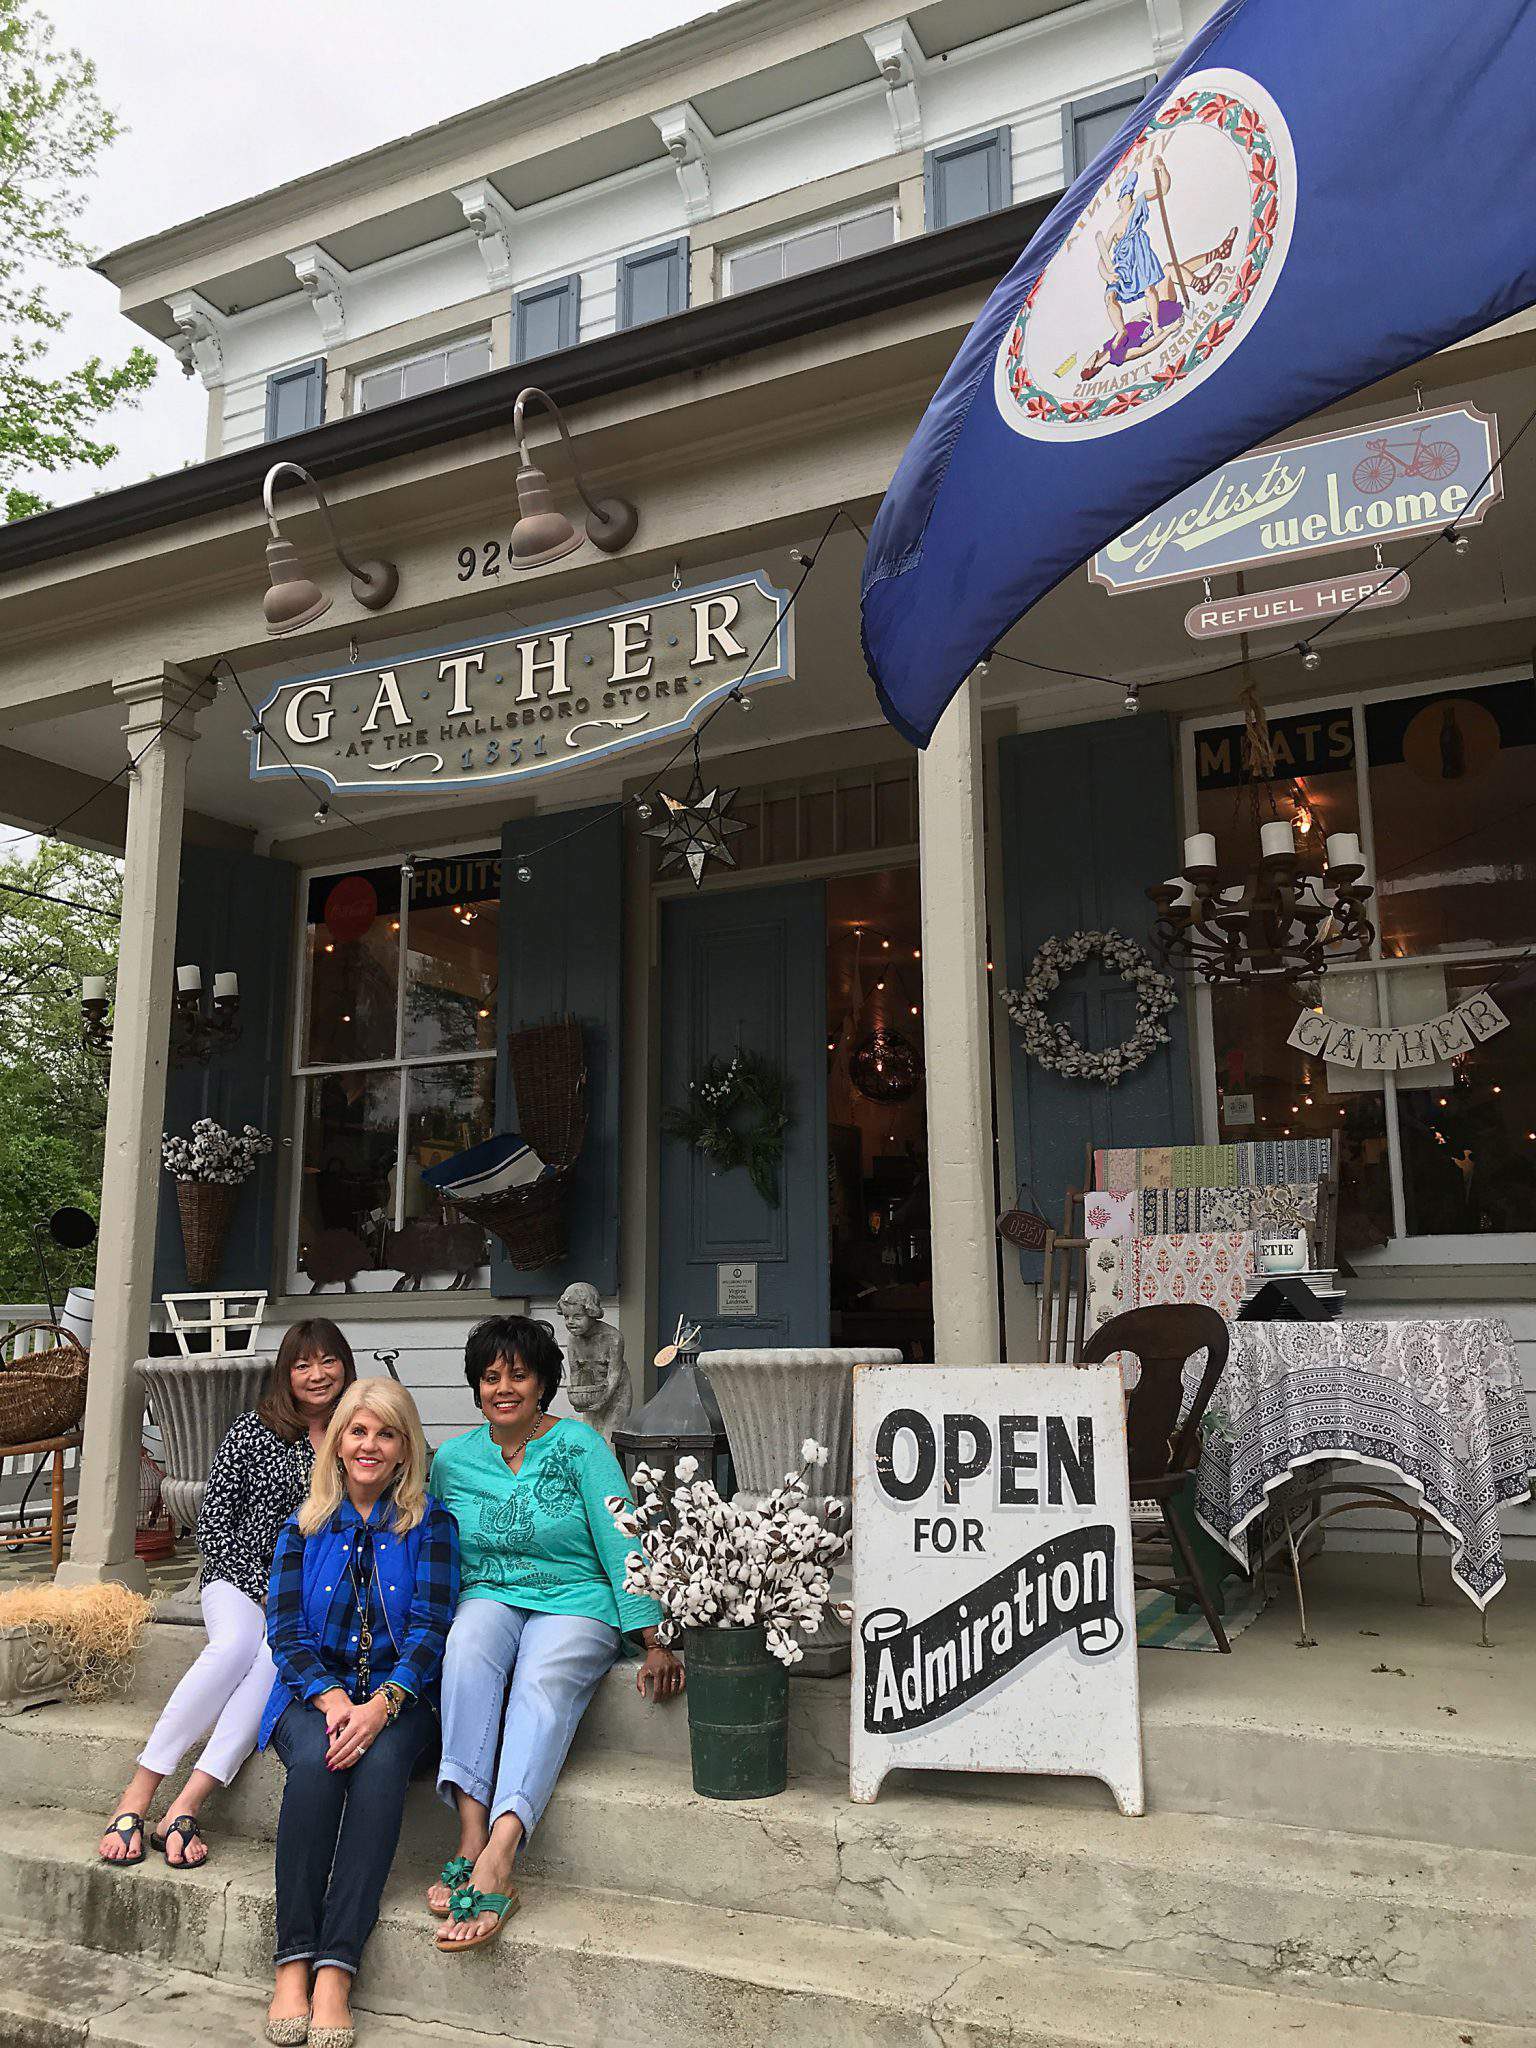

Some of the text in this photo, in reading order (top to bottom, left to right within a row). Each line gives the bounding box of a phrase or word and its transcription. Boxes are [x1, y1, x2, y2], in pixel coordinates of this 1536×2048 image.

[1106, 455, 1306, 574] Cyclists
[1260, 473, 1471, 550] welcome
[458, 540, 514, 581] 92
[1200, 582, 1394, 629] REFUEL HERE
[345, 676, 689, 758] AT THE HALLSBORO STORE
[460, 733, 549, 770] 1851
[1200, 721, 1354, 778] MATS
[1008, 1219, 1046, 1246] OPEN
[875, 1408, 1097, 1505] OPEN
[913, 1517, 986, 1553] FOR
[873, 1550, 1107, 1722] Admiration
